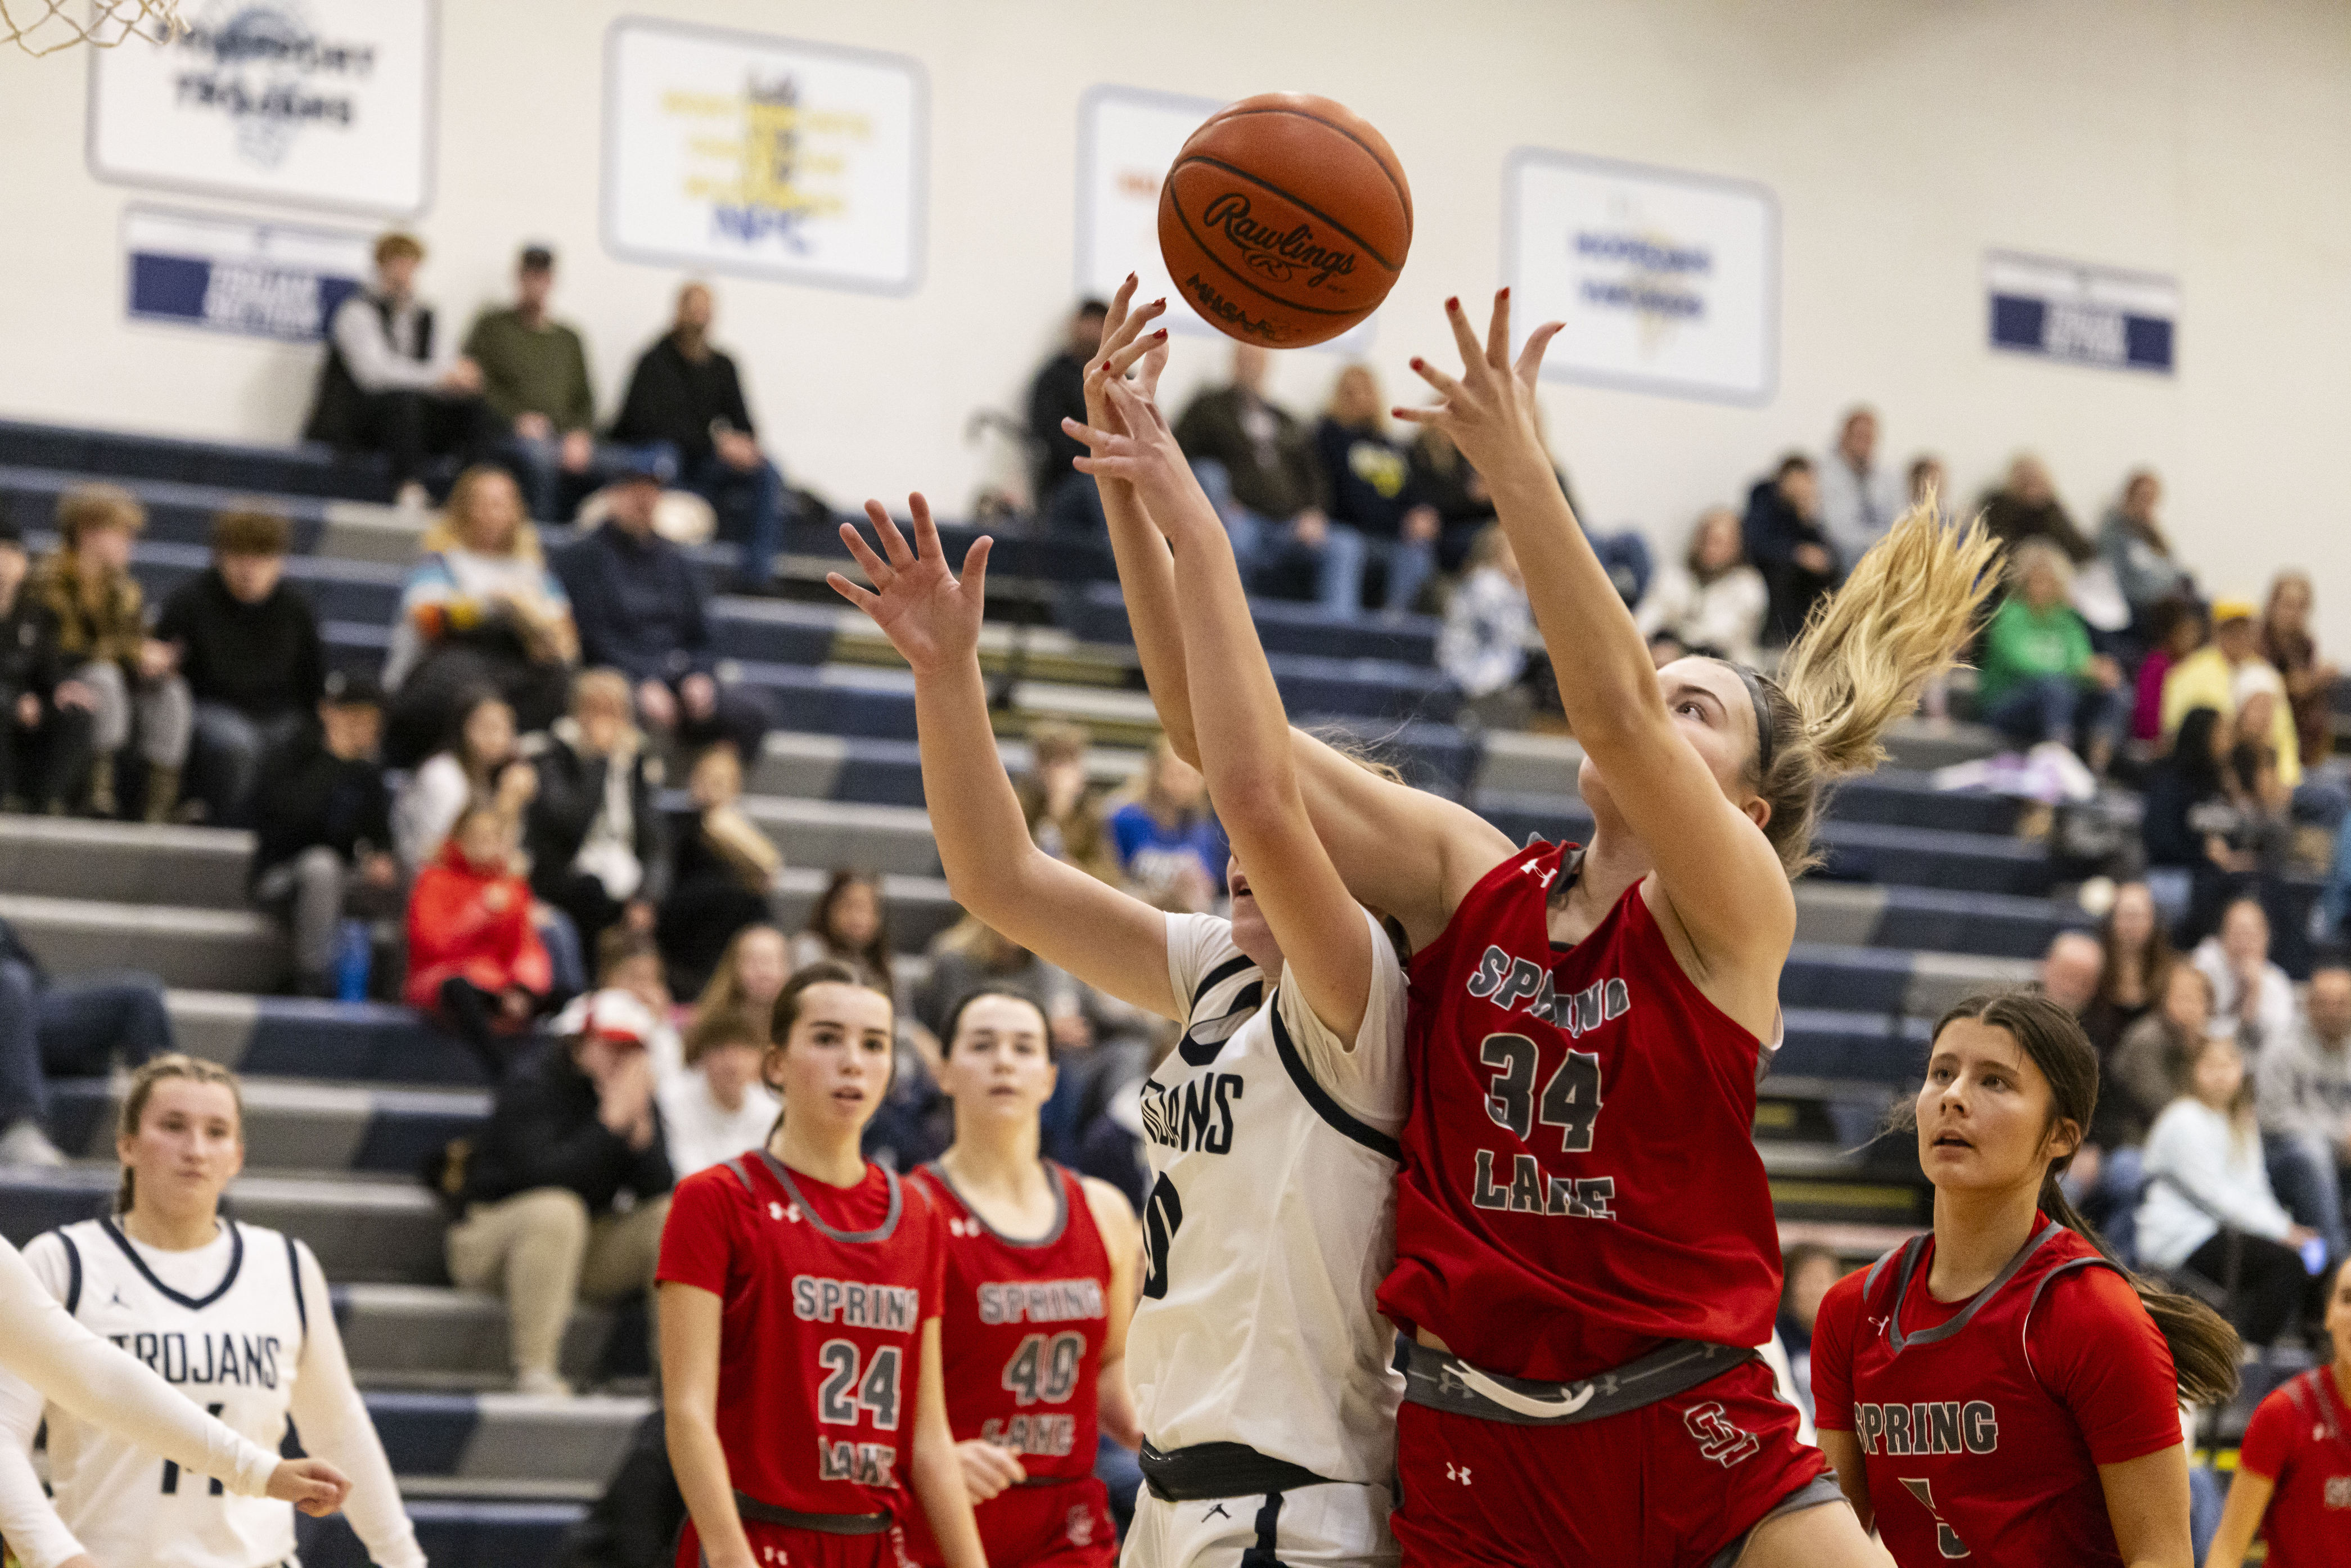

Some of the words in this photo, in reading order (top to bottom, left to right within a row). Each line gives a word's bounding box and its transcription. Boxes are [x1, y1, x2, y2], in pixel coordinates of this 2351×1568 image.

[1204, 193, 1356, 287] Rawlings
[1480, 1033, 1604, 1152] 34
[1472, 1149, 1616, 1221] LAKE
[791, 1274, 920, 1334] SPRIN
[819, 1339, 902, 1431] 24
[1002, 1331, 1087, 1406] 40
